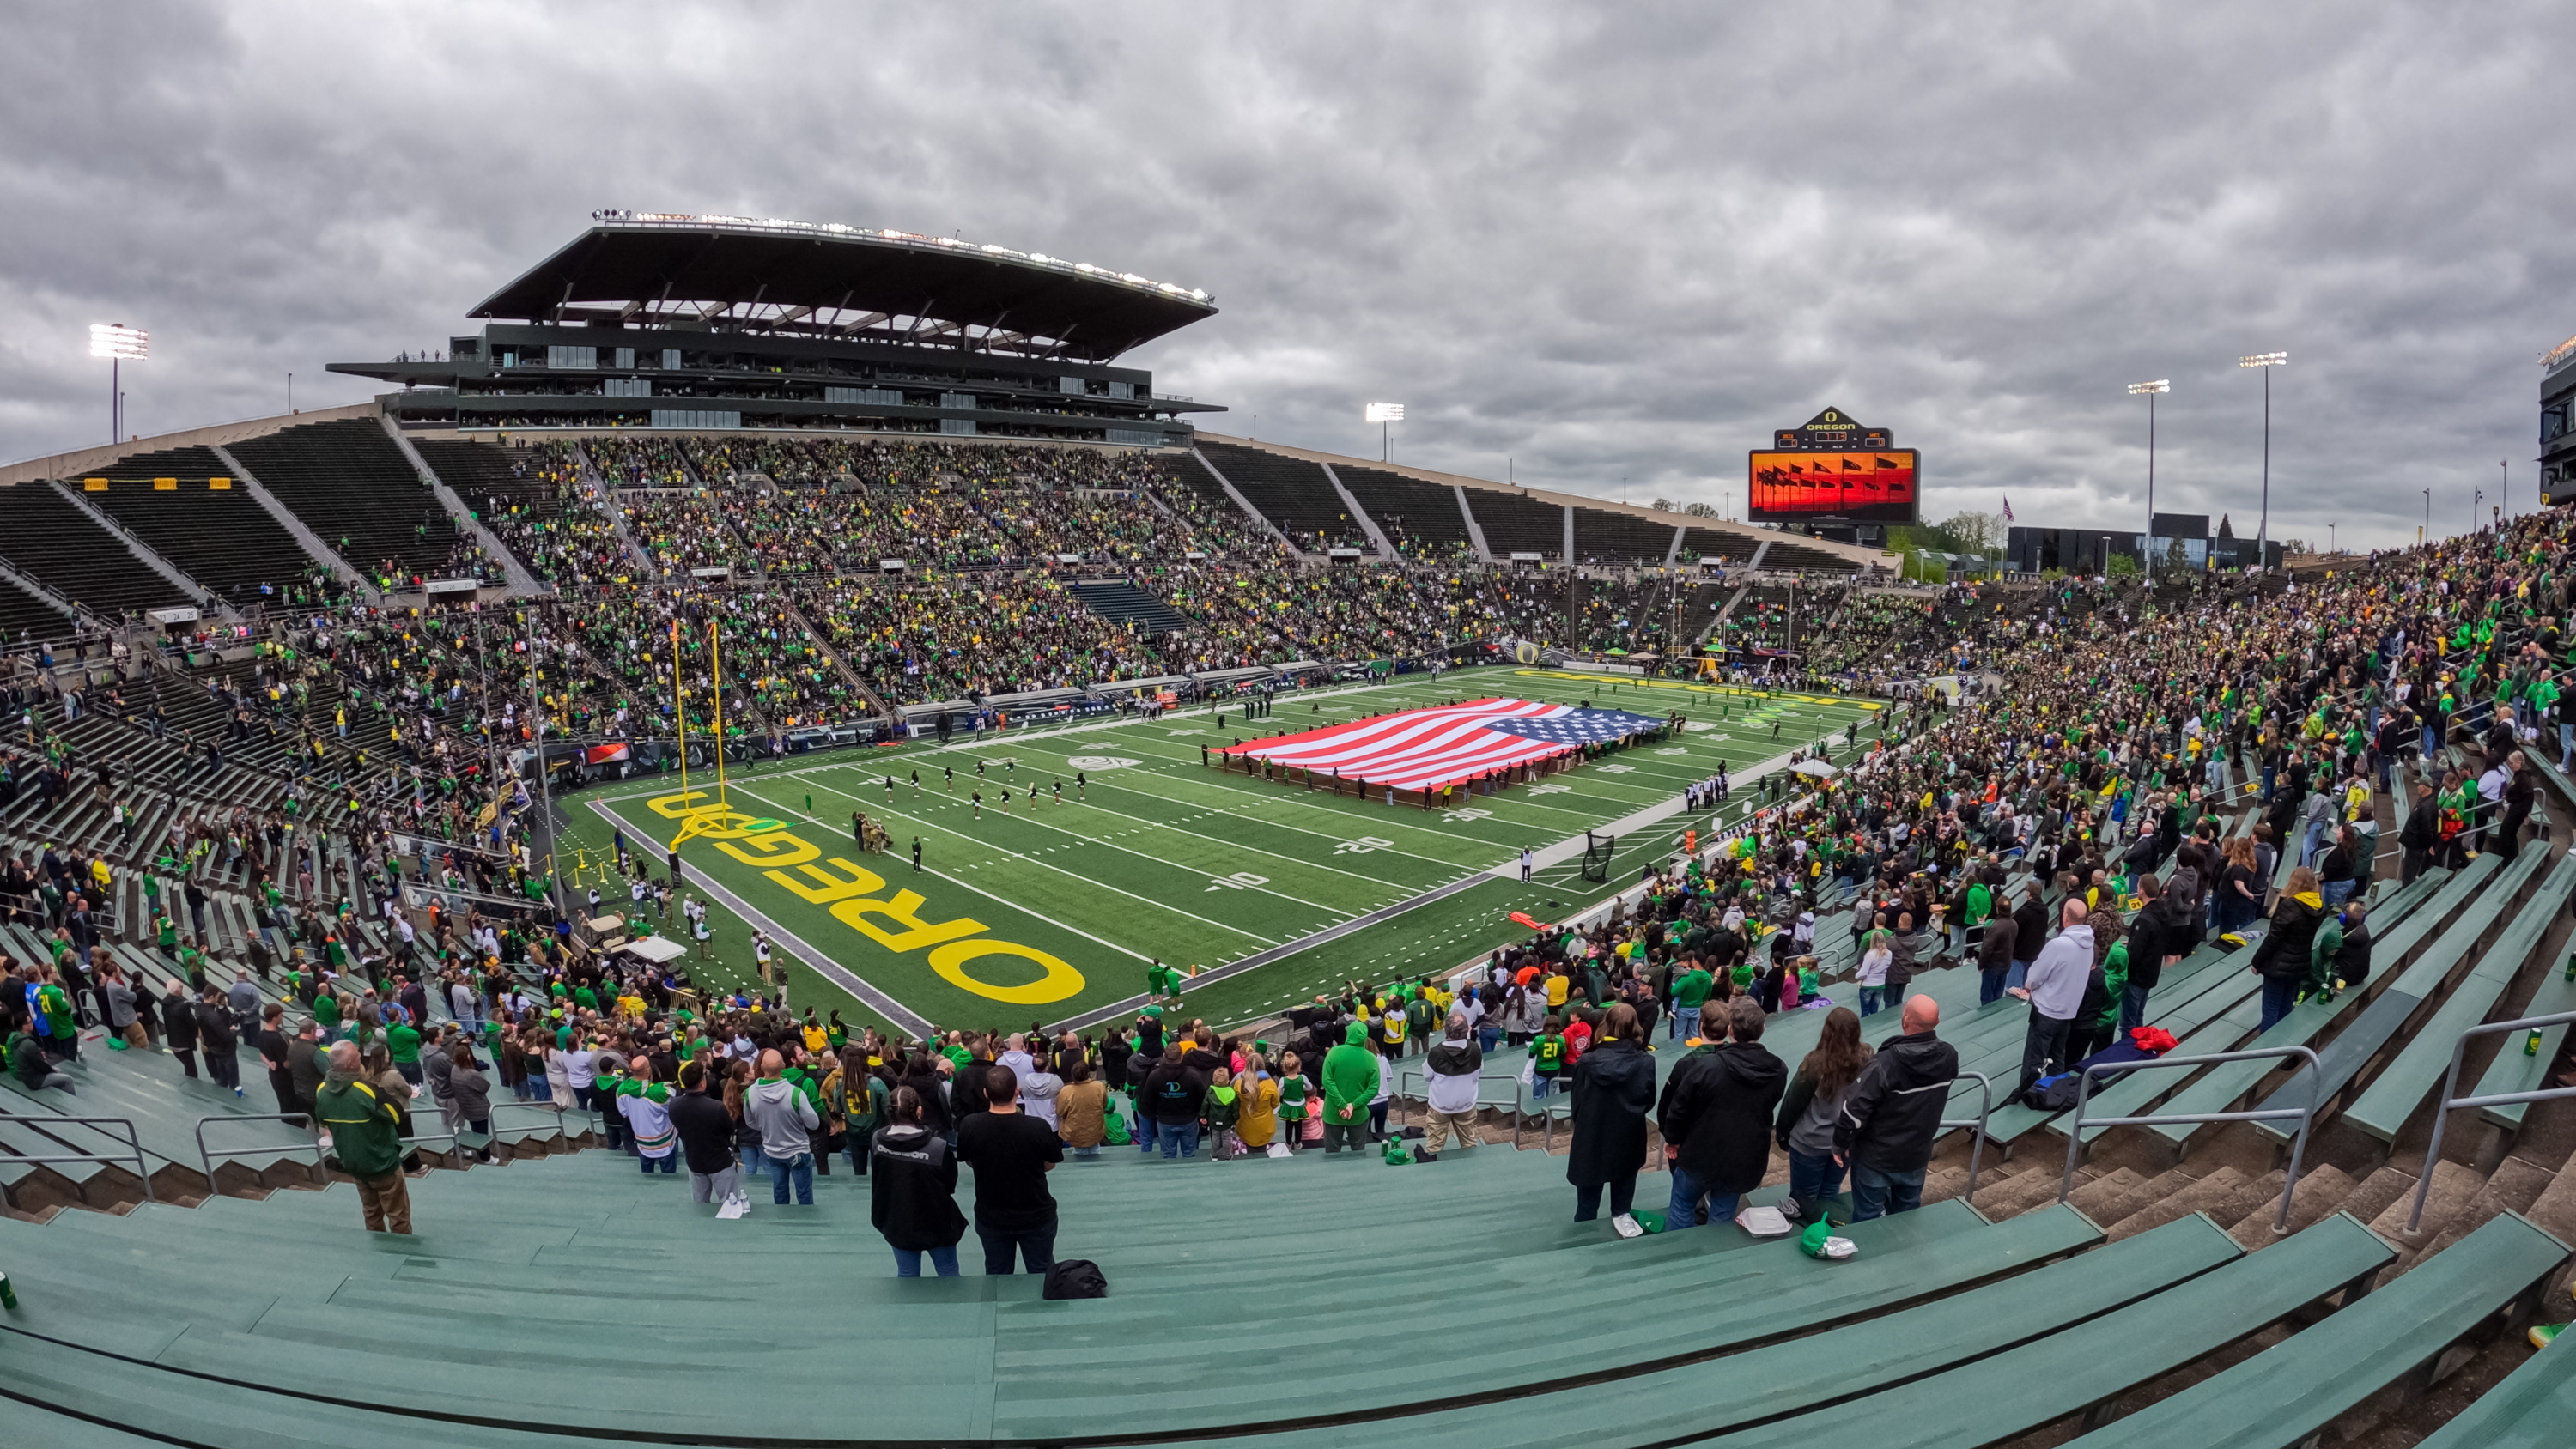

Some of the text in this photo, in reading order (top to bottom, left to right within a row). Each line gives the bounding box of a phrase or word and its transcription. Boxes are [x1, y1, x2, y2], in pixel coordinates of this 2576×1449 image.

[1825, 412, 1837, 422] O
[1958, 675, 1967, 684] 25
[1528, 783, 1572, 795] 40
[1440, 807, 1493, 822] 30
[1334, 836, 1395, 854] 20
[1210, 871, 1270, 890] 10
[646, 791, 1085, 1004] OREGON
[39, 994, 52, 1014] 21
[1420, 1005, 1425, 1018] 1
[829, 1026, 838, 1034] 20
[1543, 1042, 1558, 1058] 21
